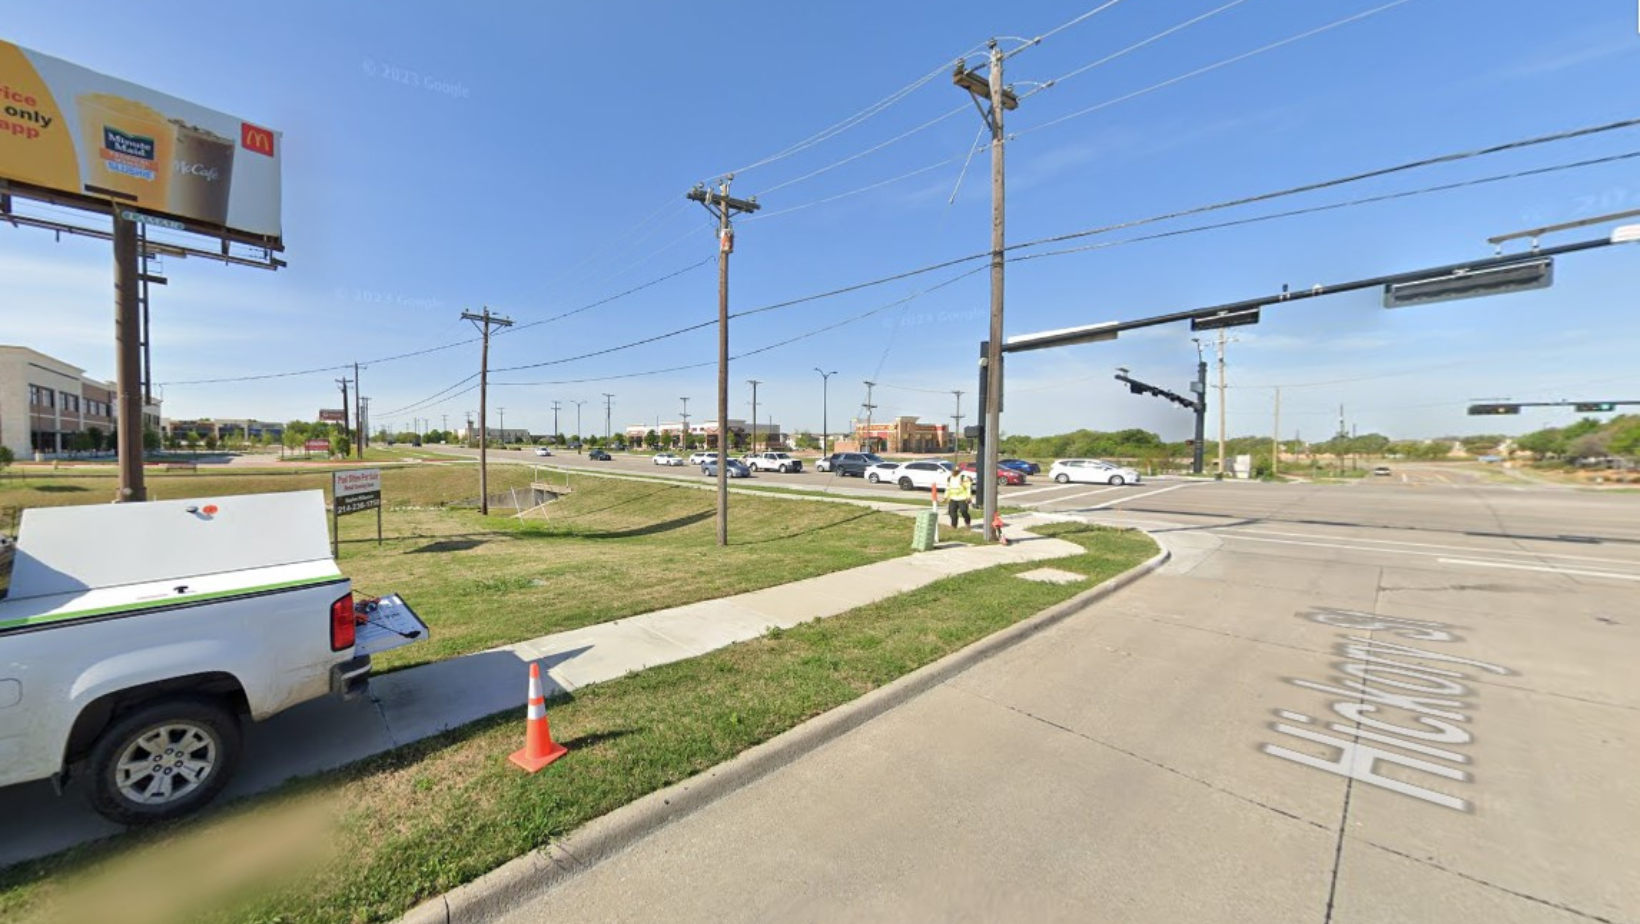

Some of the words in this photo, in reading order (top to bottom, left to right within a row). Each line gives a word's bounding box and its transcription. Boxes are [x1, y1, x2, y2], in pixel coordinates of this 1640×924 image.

[4, 105, 52, 129] only
[0, 118, 40, 140] app
[108, 131, 152, 151] Minute
[114, 142, 147, 157] Maid
[108, 161, 154, 180] SLUSHIE
